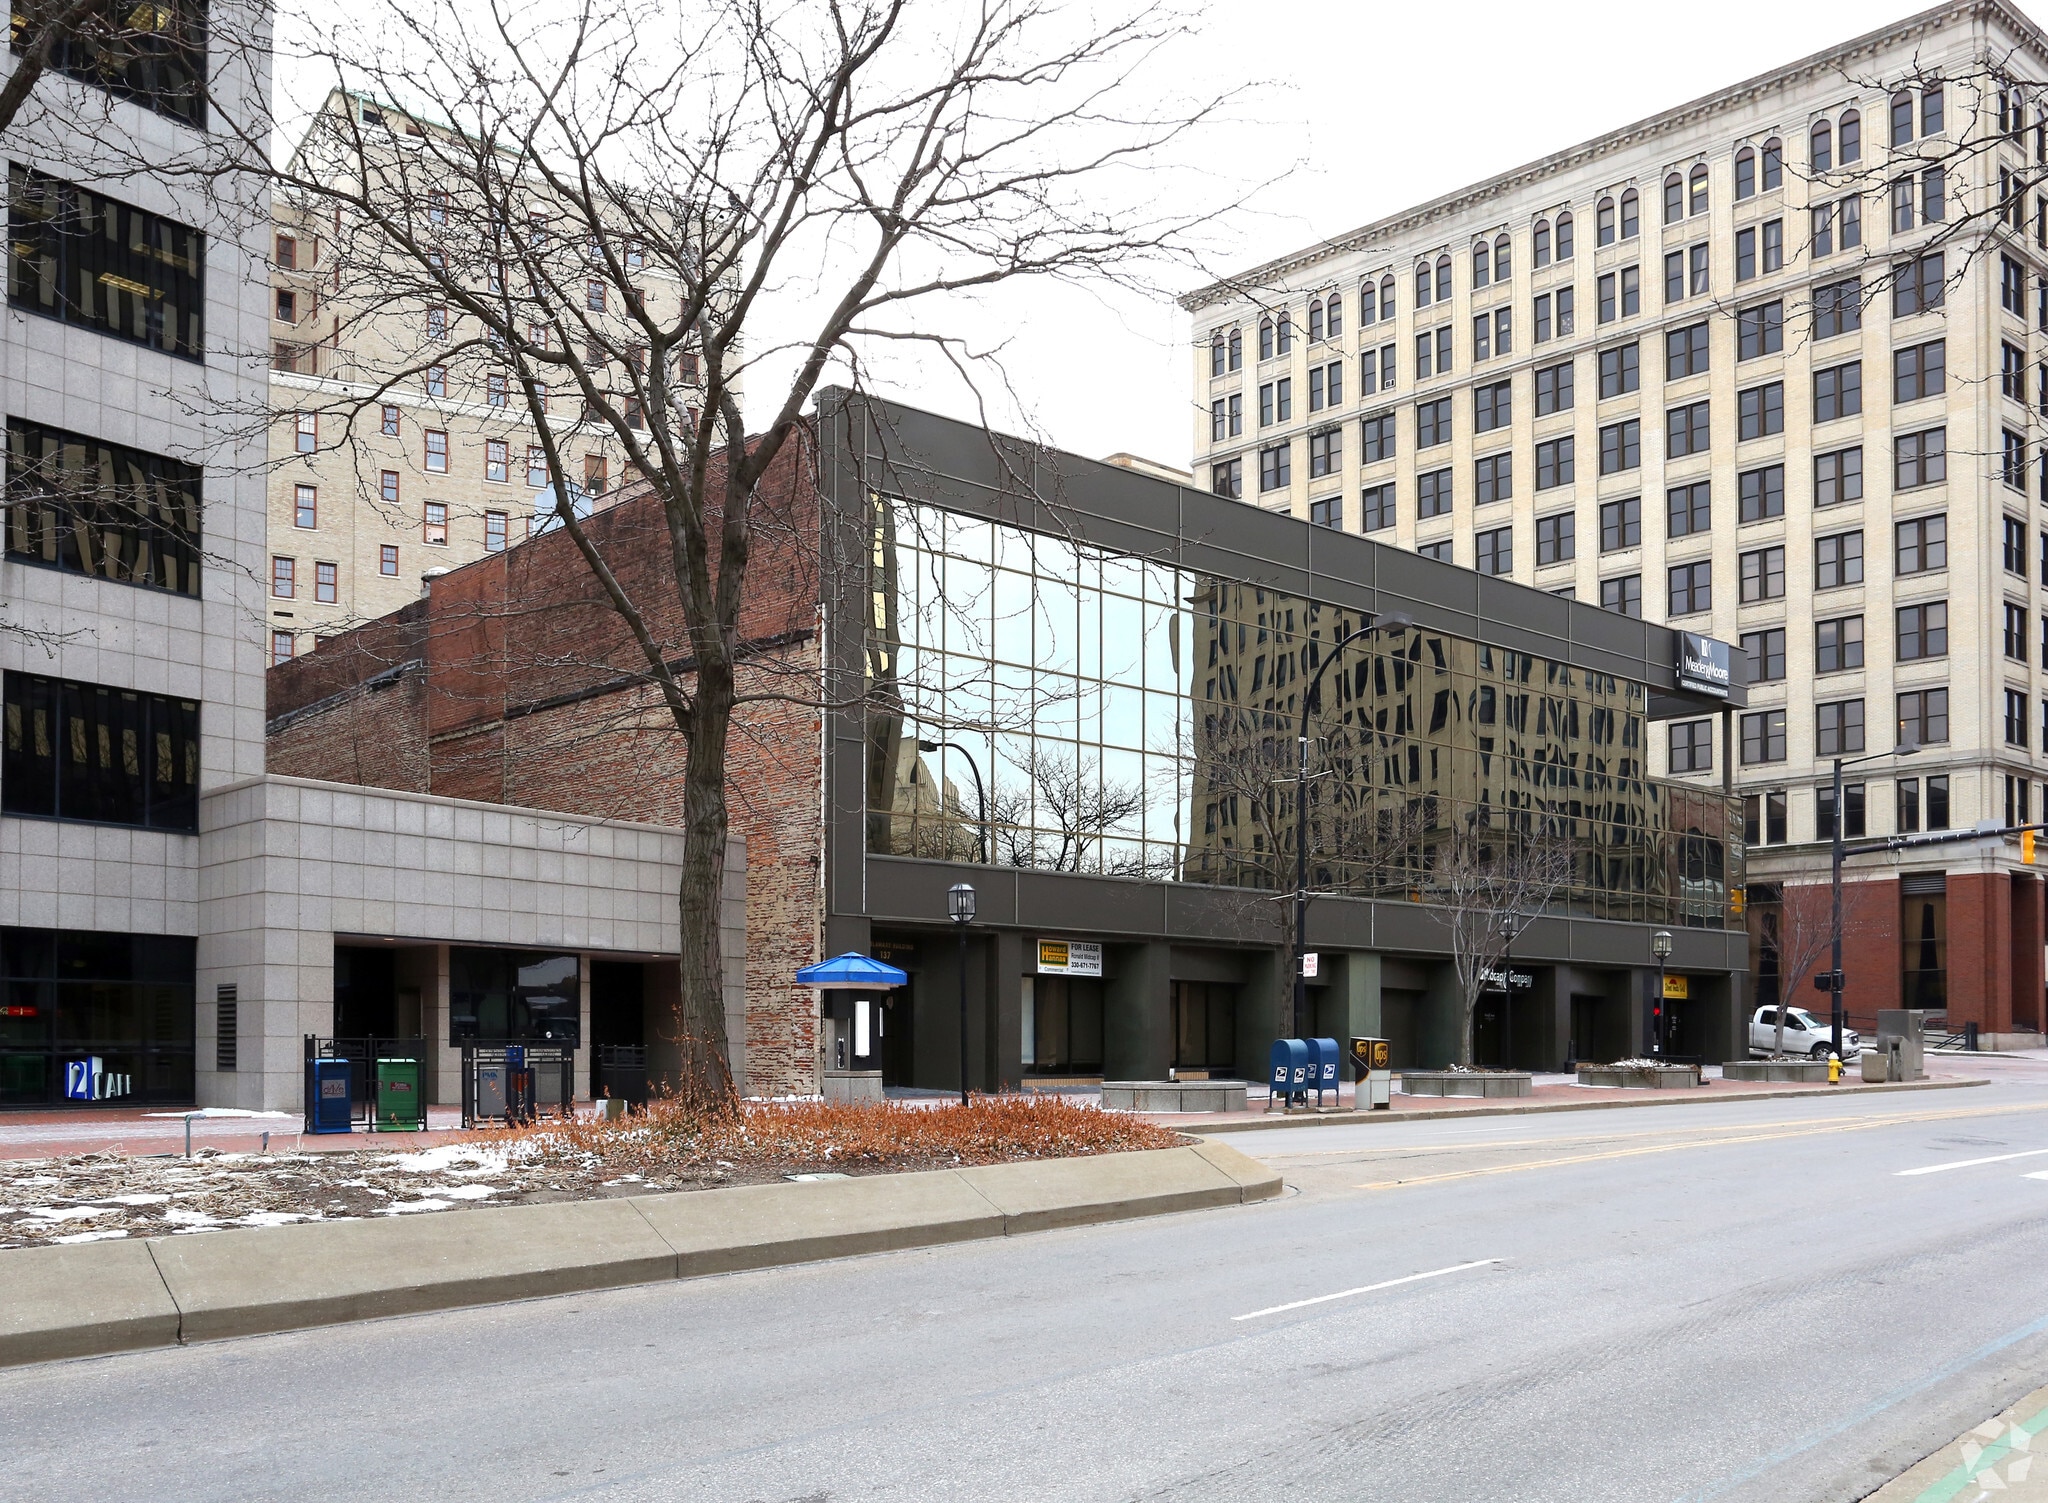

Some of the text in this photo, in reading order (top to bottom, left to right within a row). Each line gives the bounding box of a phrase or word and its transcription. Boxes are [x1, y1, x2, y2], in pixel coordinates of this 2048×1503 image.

[1071, 943, 1099, 952] FOR LEASE
[880, 951, 891, 959] 137
[1509, 970, 1533, 987] Company
